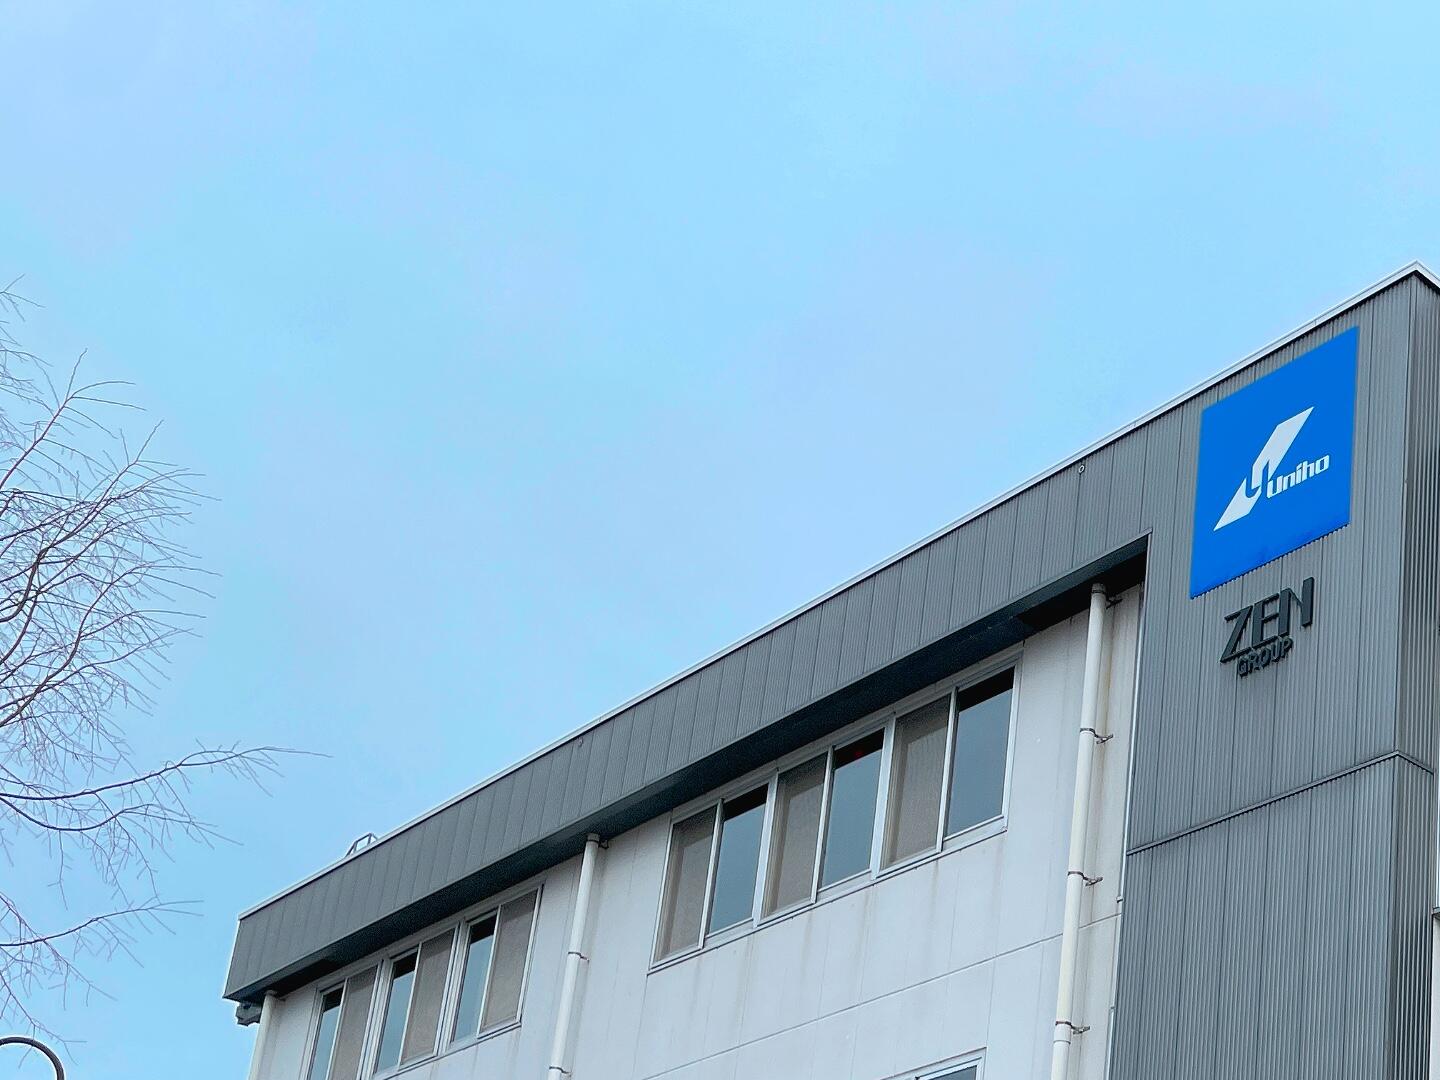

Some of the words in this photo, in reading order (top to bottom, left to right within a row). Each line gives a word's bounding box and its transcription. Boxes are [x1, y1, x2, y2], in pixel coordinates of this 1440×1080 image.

[1265, 454, 1330, 499] Uniho
[1219, 576, 1315, 664] ZEN
[1237, 637, 1294, 678] GROUP
